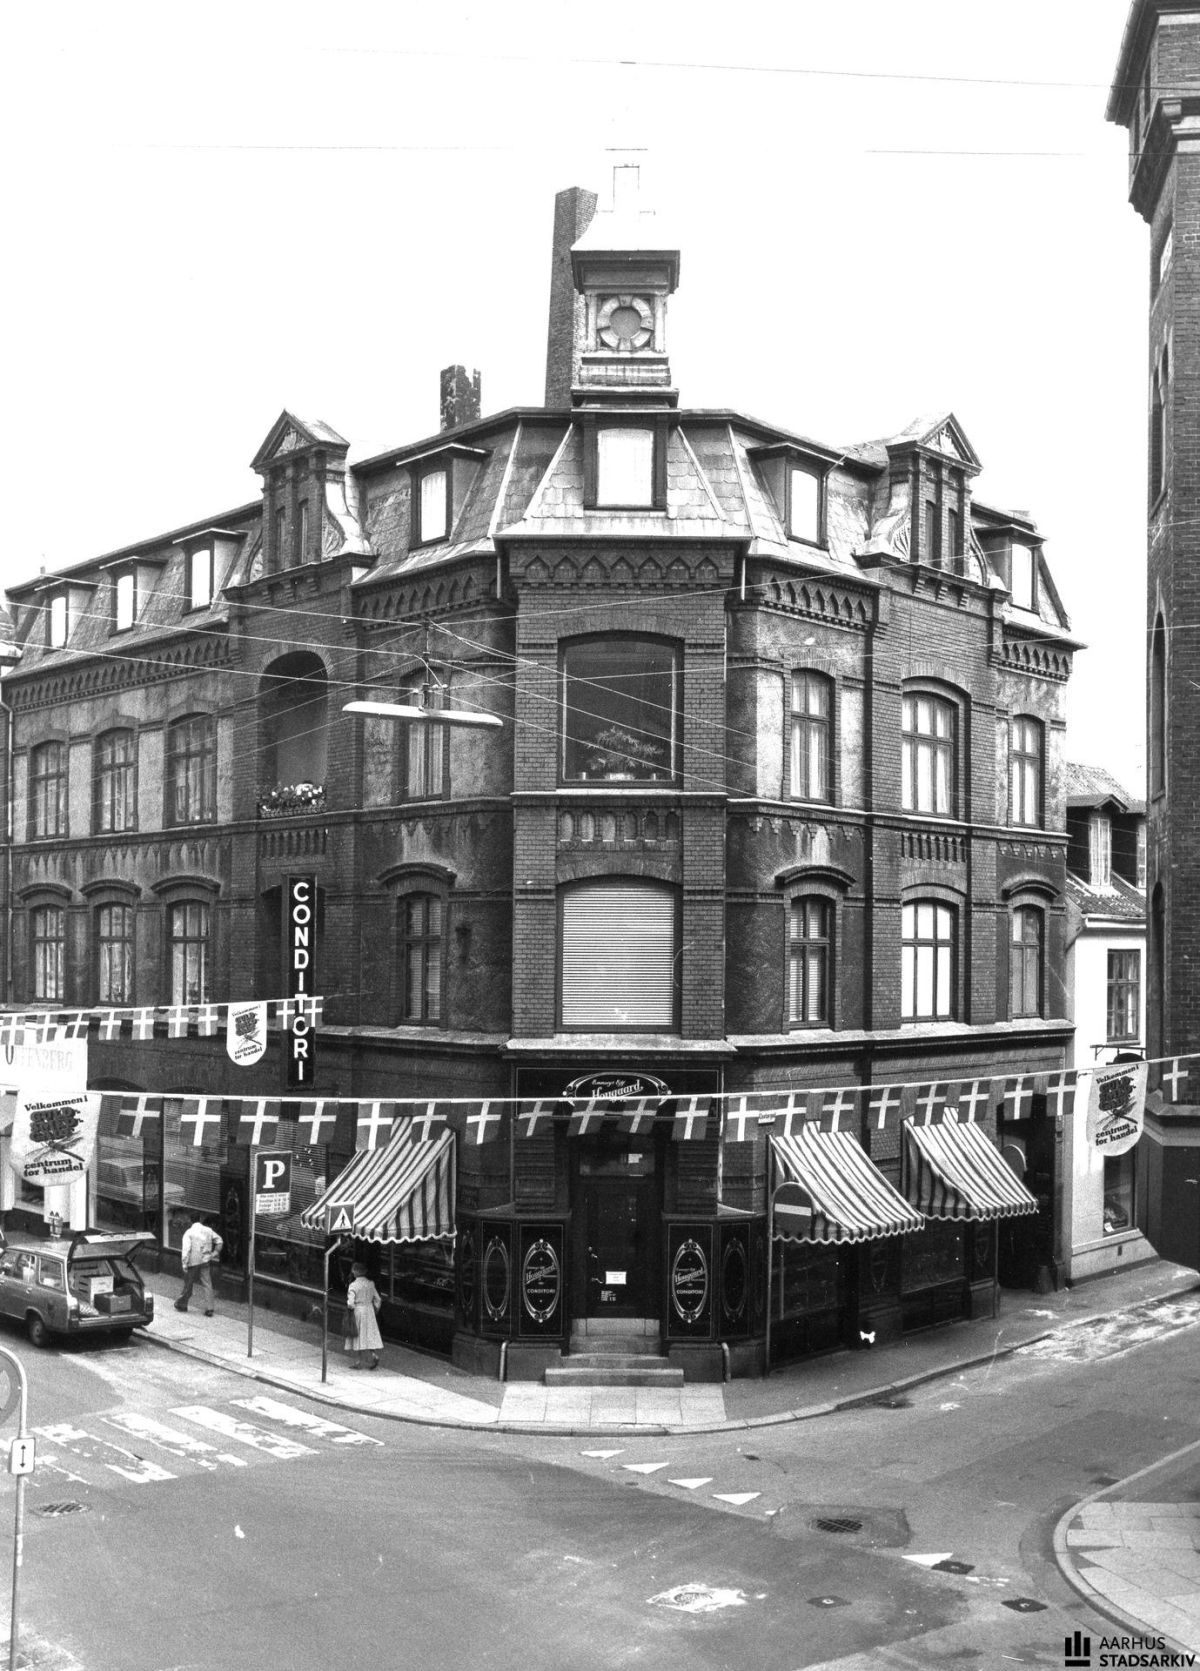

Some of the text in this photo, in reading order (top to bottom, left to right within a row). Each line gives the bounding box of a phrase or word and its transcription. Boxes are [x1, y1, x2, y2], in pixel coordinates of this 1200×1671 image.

[292, 881, 311, 1081] CONDITORI
[1095, 1066, 1136, 1084] Velkommen
[24, 1097, 83, 1111] Velkommen
[1095, 1125, 1138, 1146] for handel
[1096, 1123, 1130, 1138] centrum
[24, 1159, 72, 1170] centrum
[43, 1163, 84, 1174] handel
[262, 1160, 286, 1189] P
